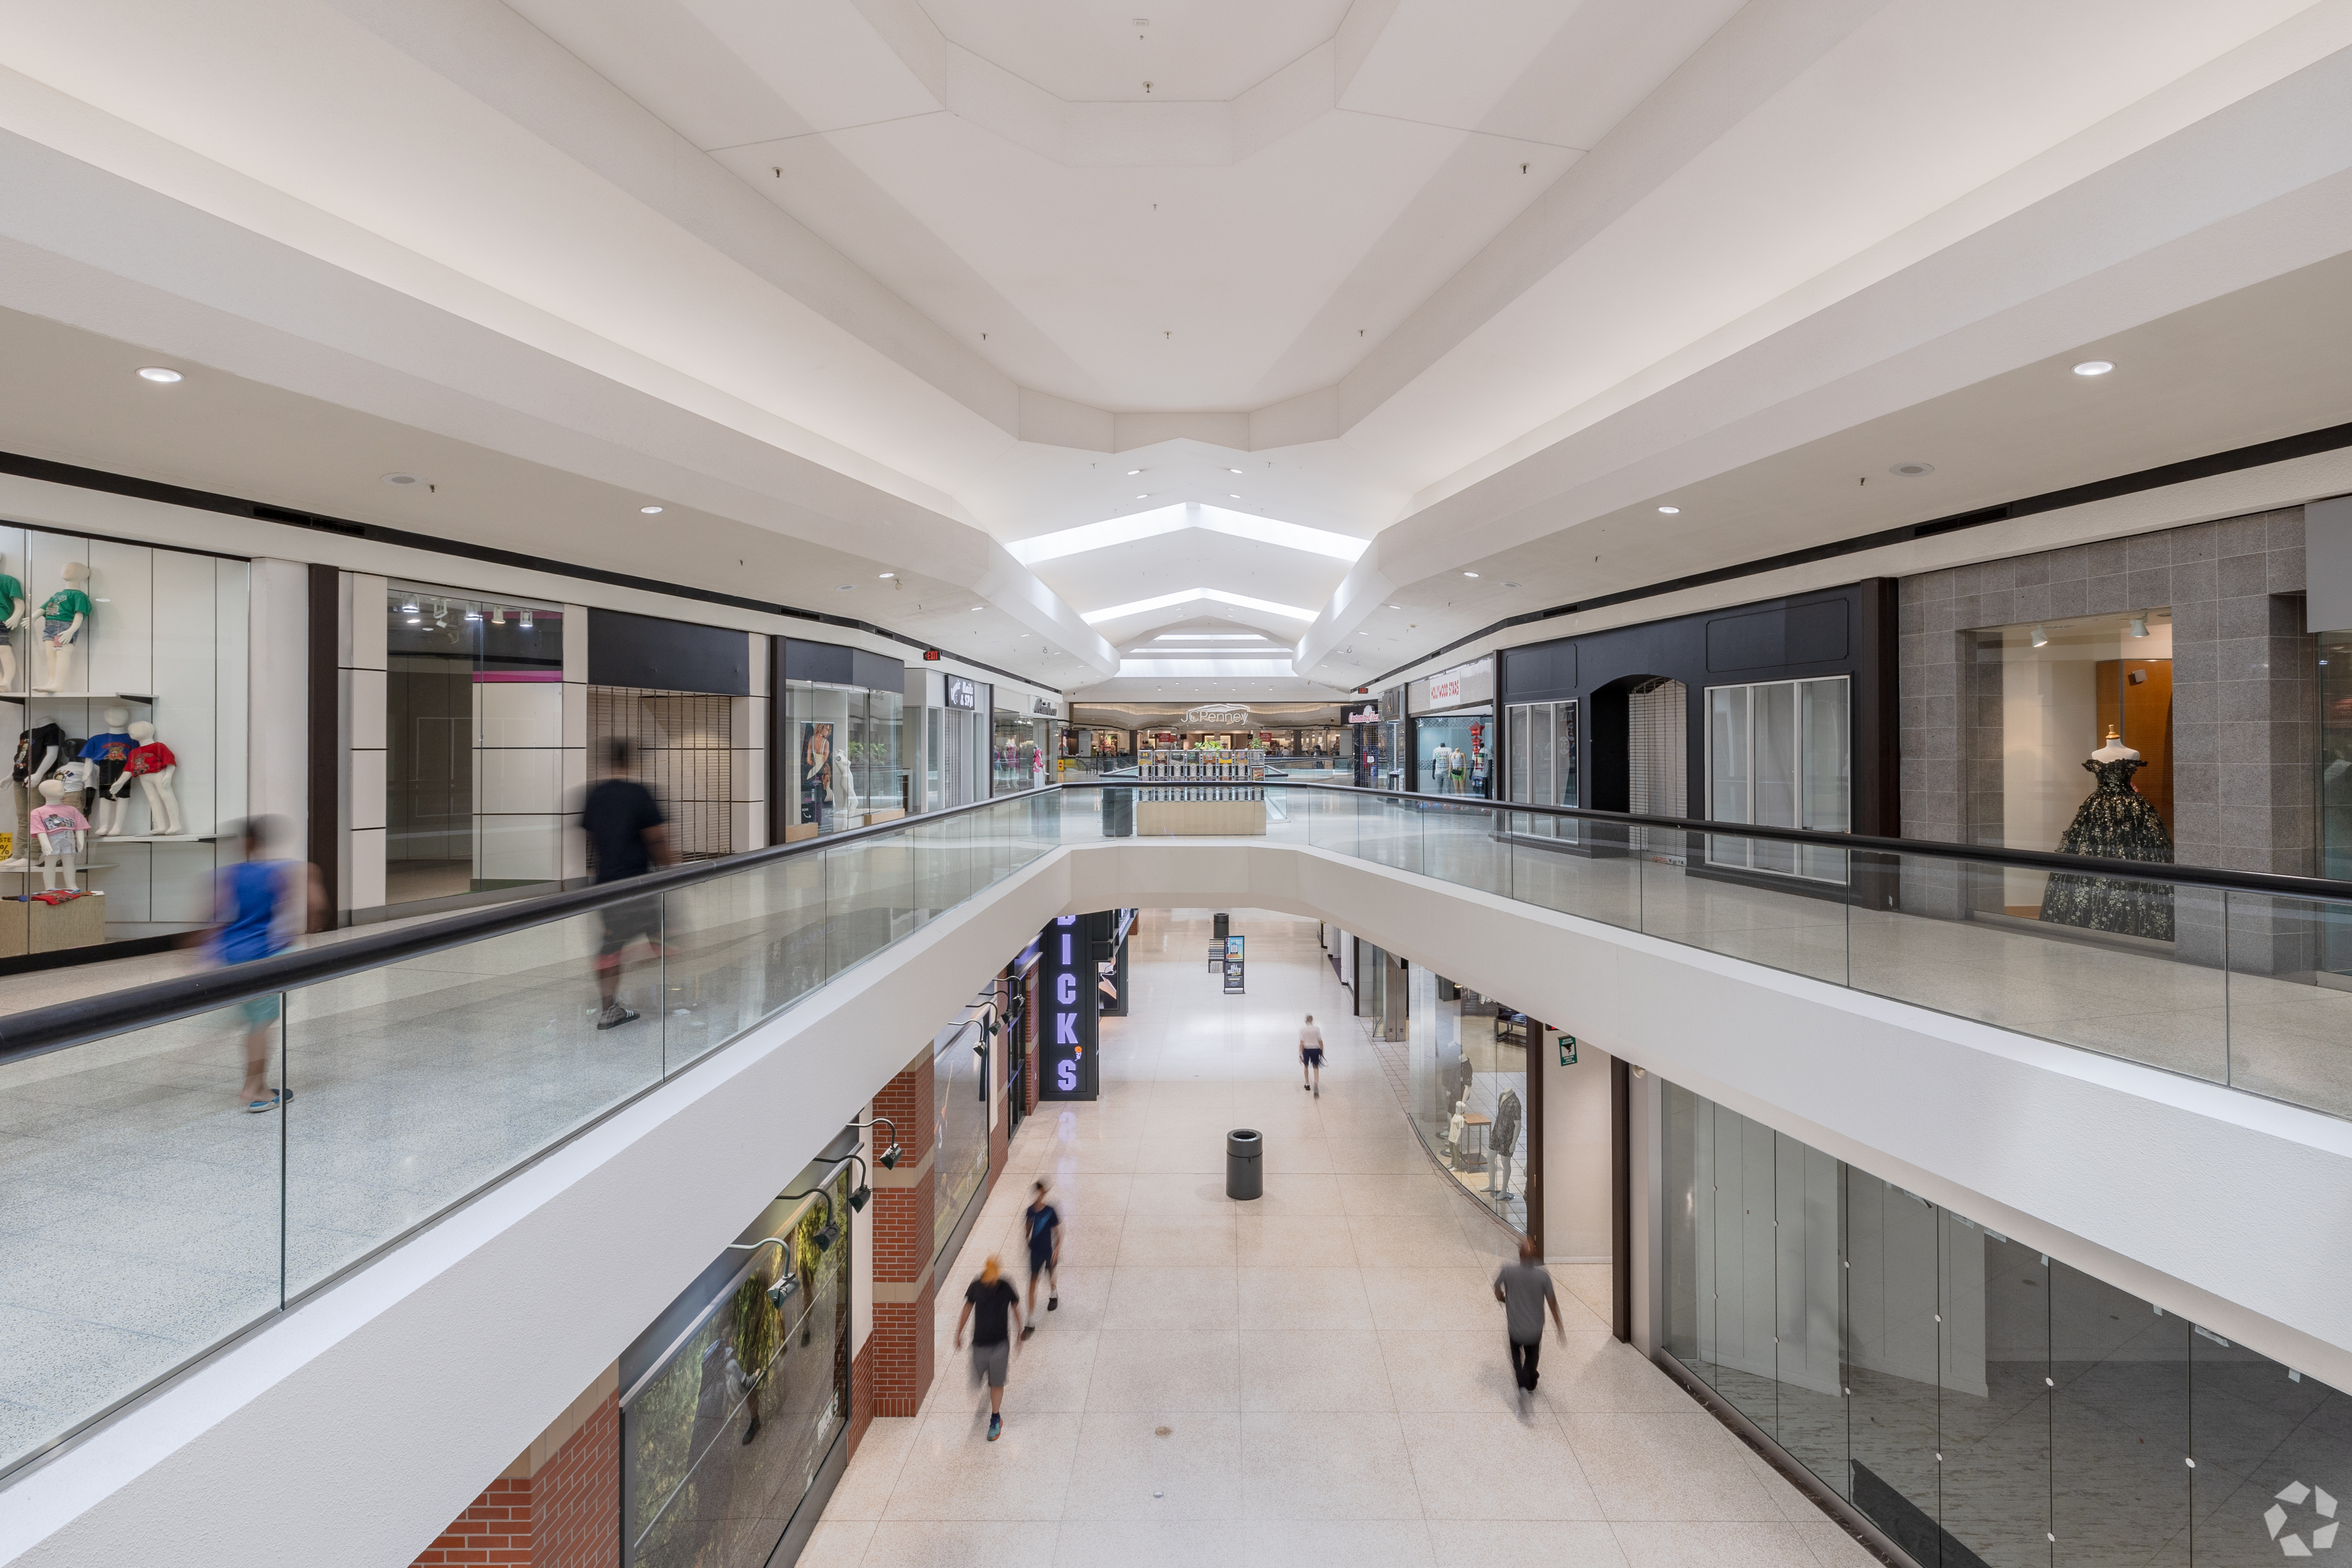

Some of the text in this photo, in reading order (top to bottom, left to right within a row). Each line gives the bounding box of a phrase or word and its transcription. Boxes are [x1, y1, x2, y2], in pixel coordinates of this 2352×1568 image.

[927, 651, 938, 660] EXIT
[962, 681, 973, 695] Nails
[1431, 679, 1459, 700] HOLLYWOOD STARS
[960, 694, 973, 708] & SPA
[1033, 698, 1057, 716] Rainbow
[1181, 710, 1248, 725] JCPenney
[1348, 711, 1370, 724] Customized
[818, 1389, 839, 1441] DICK'S
